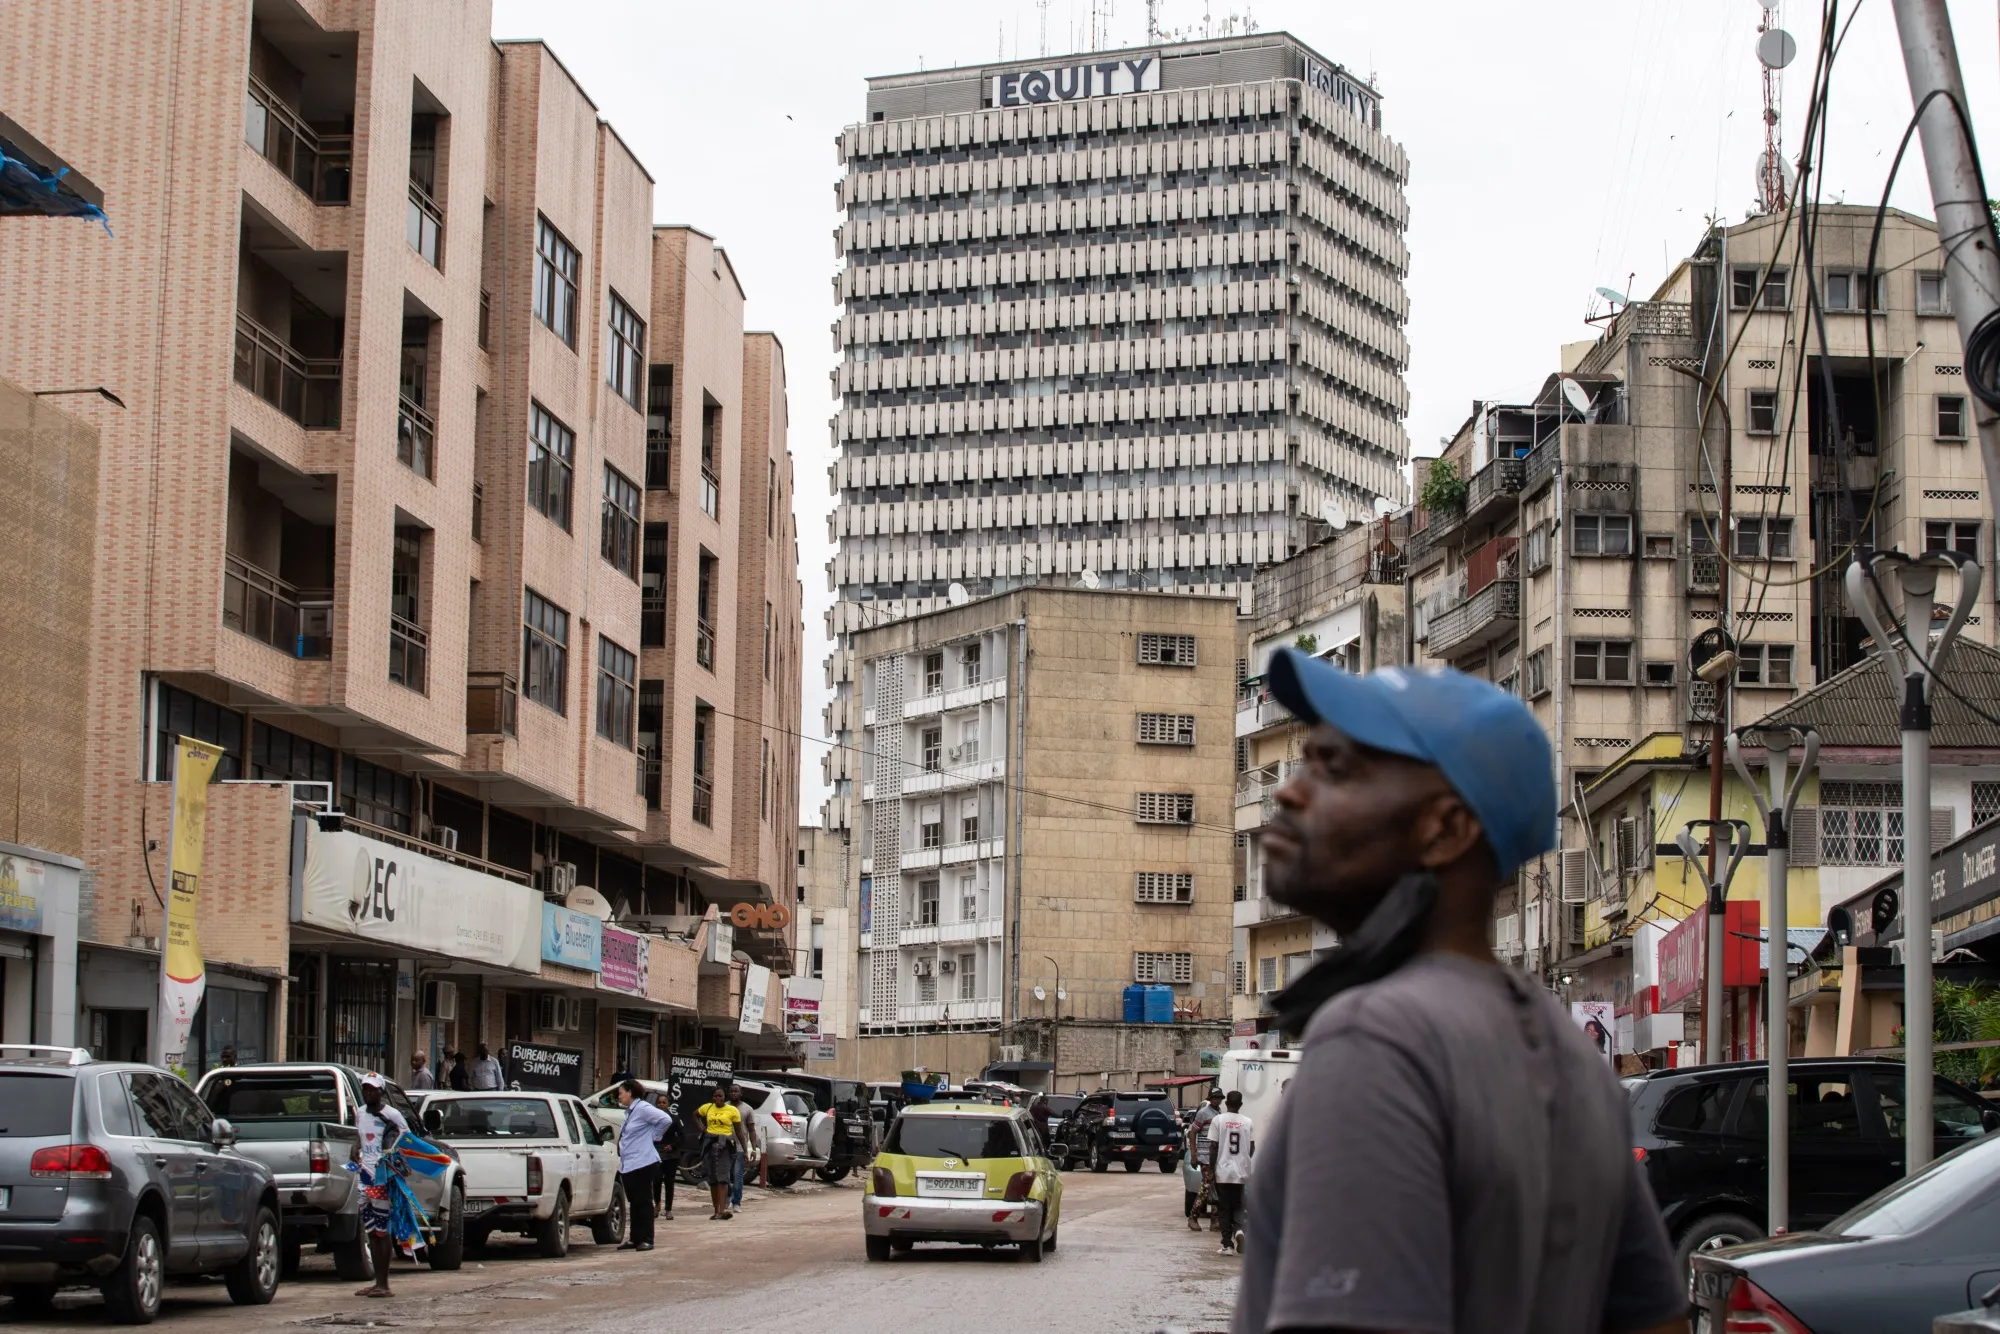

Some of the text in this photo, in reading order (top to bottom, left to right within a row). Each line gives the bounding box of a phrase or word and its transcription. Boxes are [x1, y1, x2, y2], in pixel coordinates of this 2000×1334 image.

[1000, 58, 1153, 106] EQUITY
[1307, 57, 1369, 123] EQUITY
[565, 923, 596, 956] Blueberry
[512, 1045, 548, 1063] BUREAU
[552, 1052, 580, 1066] CHANGE
[672, 1056, 699, 1068] BUREAU
[705, 1060, 732, 1072] CHANGE
[522, 1060, 561, 1076] SIMKA
[1242, 1063, 1265, 1072] TATA
[1229, 1131, 1240, 1155] 9
